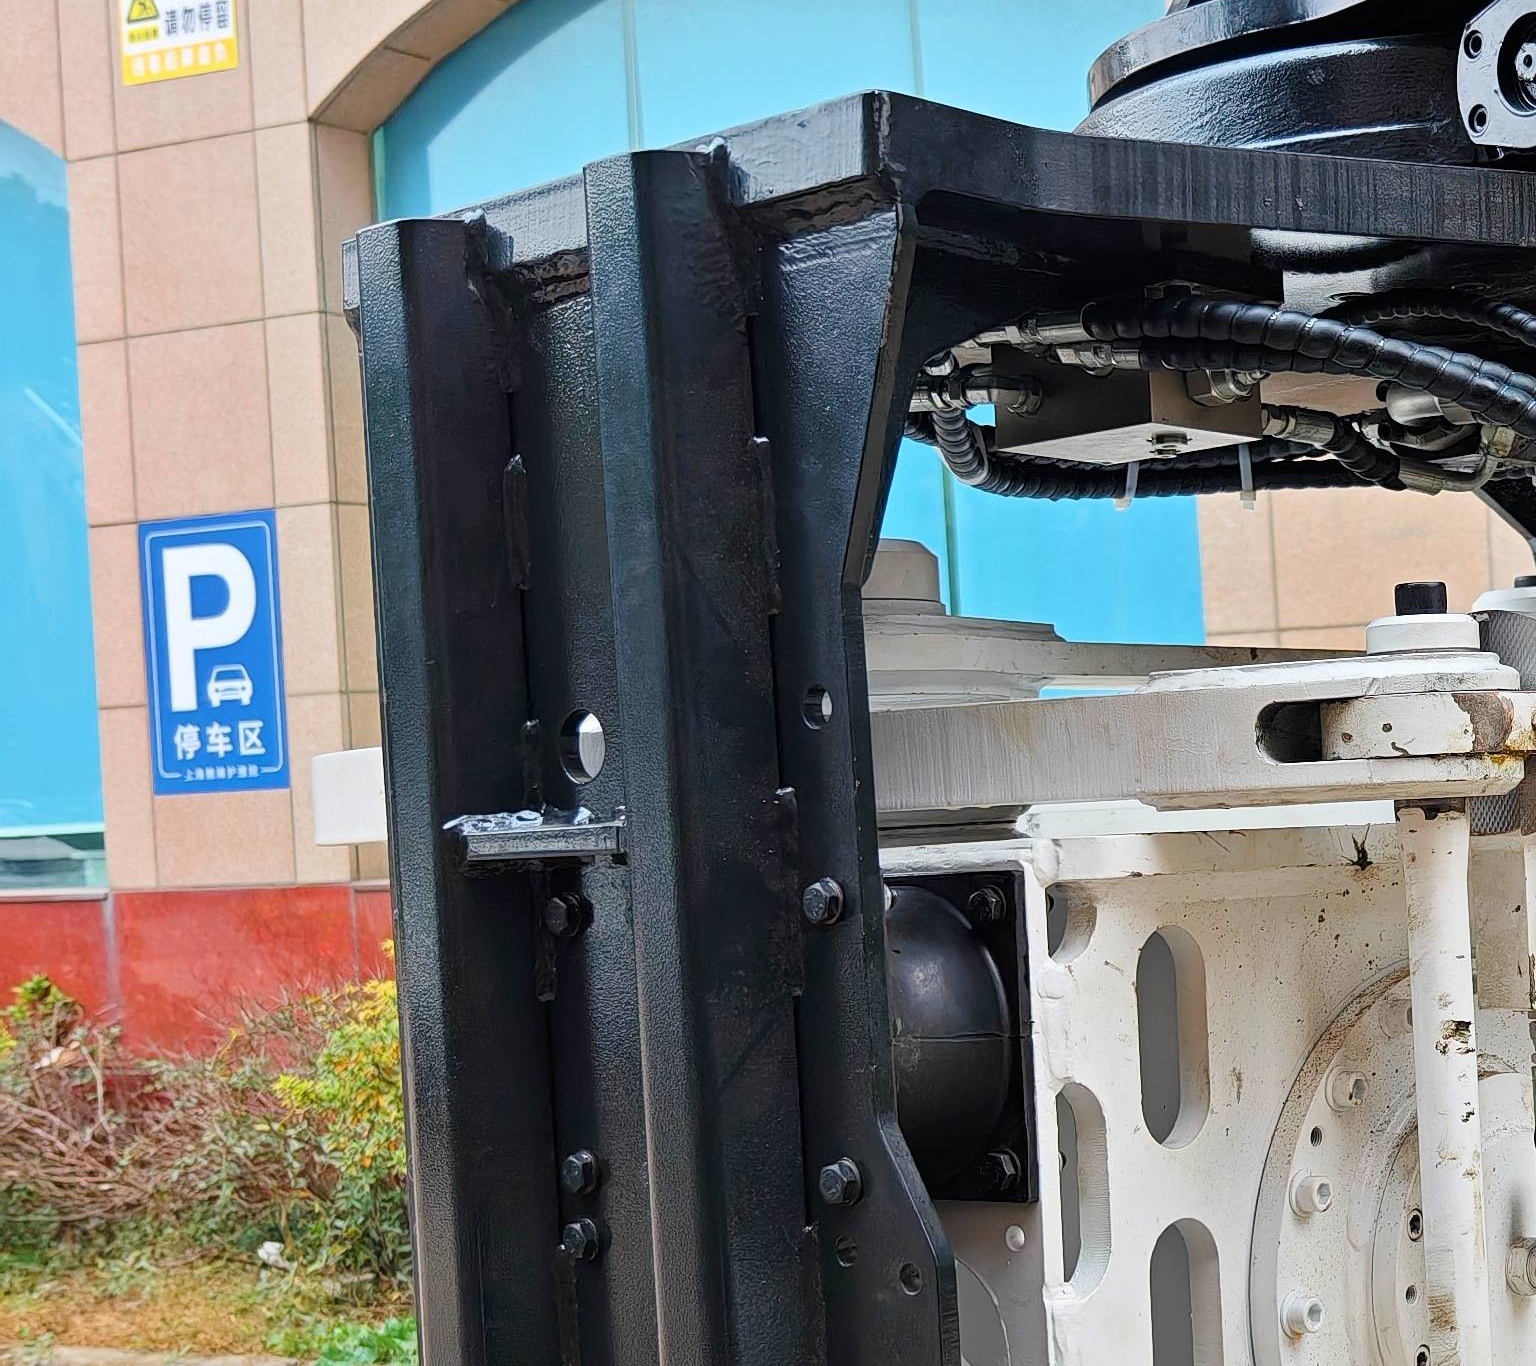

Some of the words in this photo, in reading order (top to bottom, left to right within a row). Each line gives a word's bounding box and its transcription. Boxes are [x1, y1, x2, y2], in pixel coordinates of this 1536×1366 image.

[161, 542, 257, 713] P
[173, 718, 267, 762] 停车区
